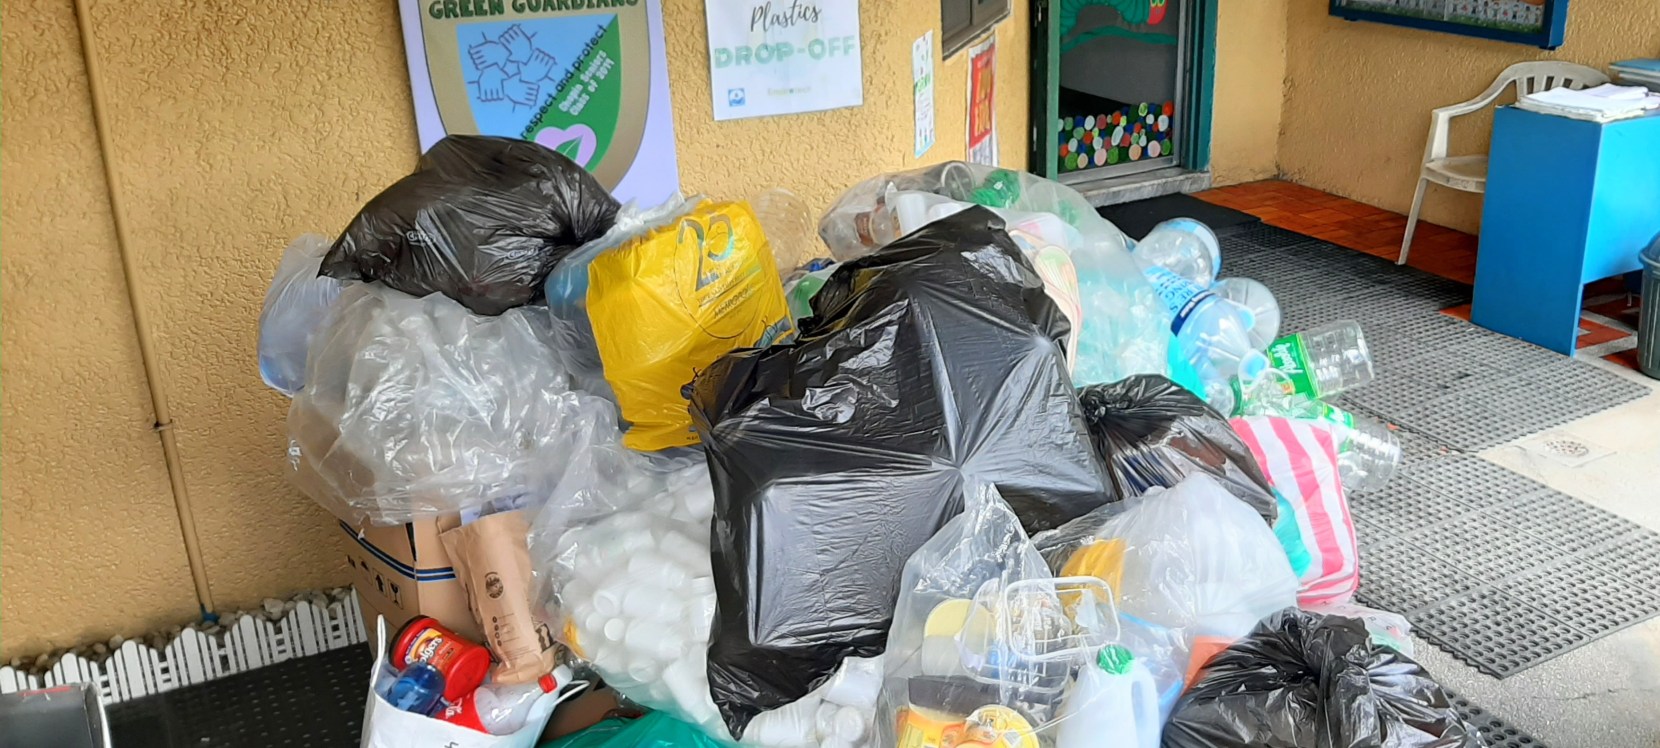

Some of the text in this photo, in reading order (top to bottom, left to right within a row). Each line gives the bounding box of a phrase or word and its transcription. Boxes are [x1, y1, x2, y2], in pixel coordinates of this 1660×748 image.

[428, 0, 504, 19] GREEN
[750, 0, 821, 32] Plastics
[714, 35, 855, 69] DROP-OFF
[520, 24, 608, 140] respect and protect
